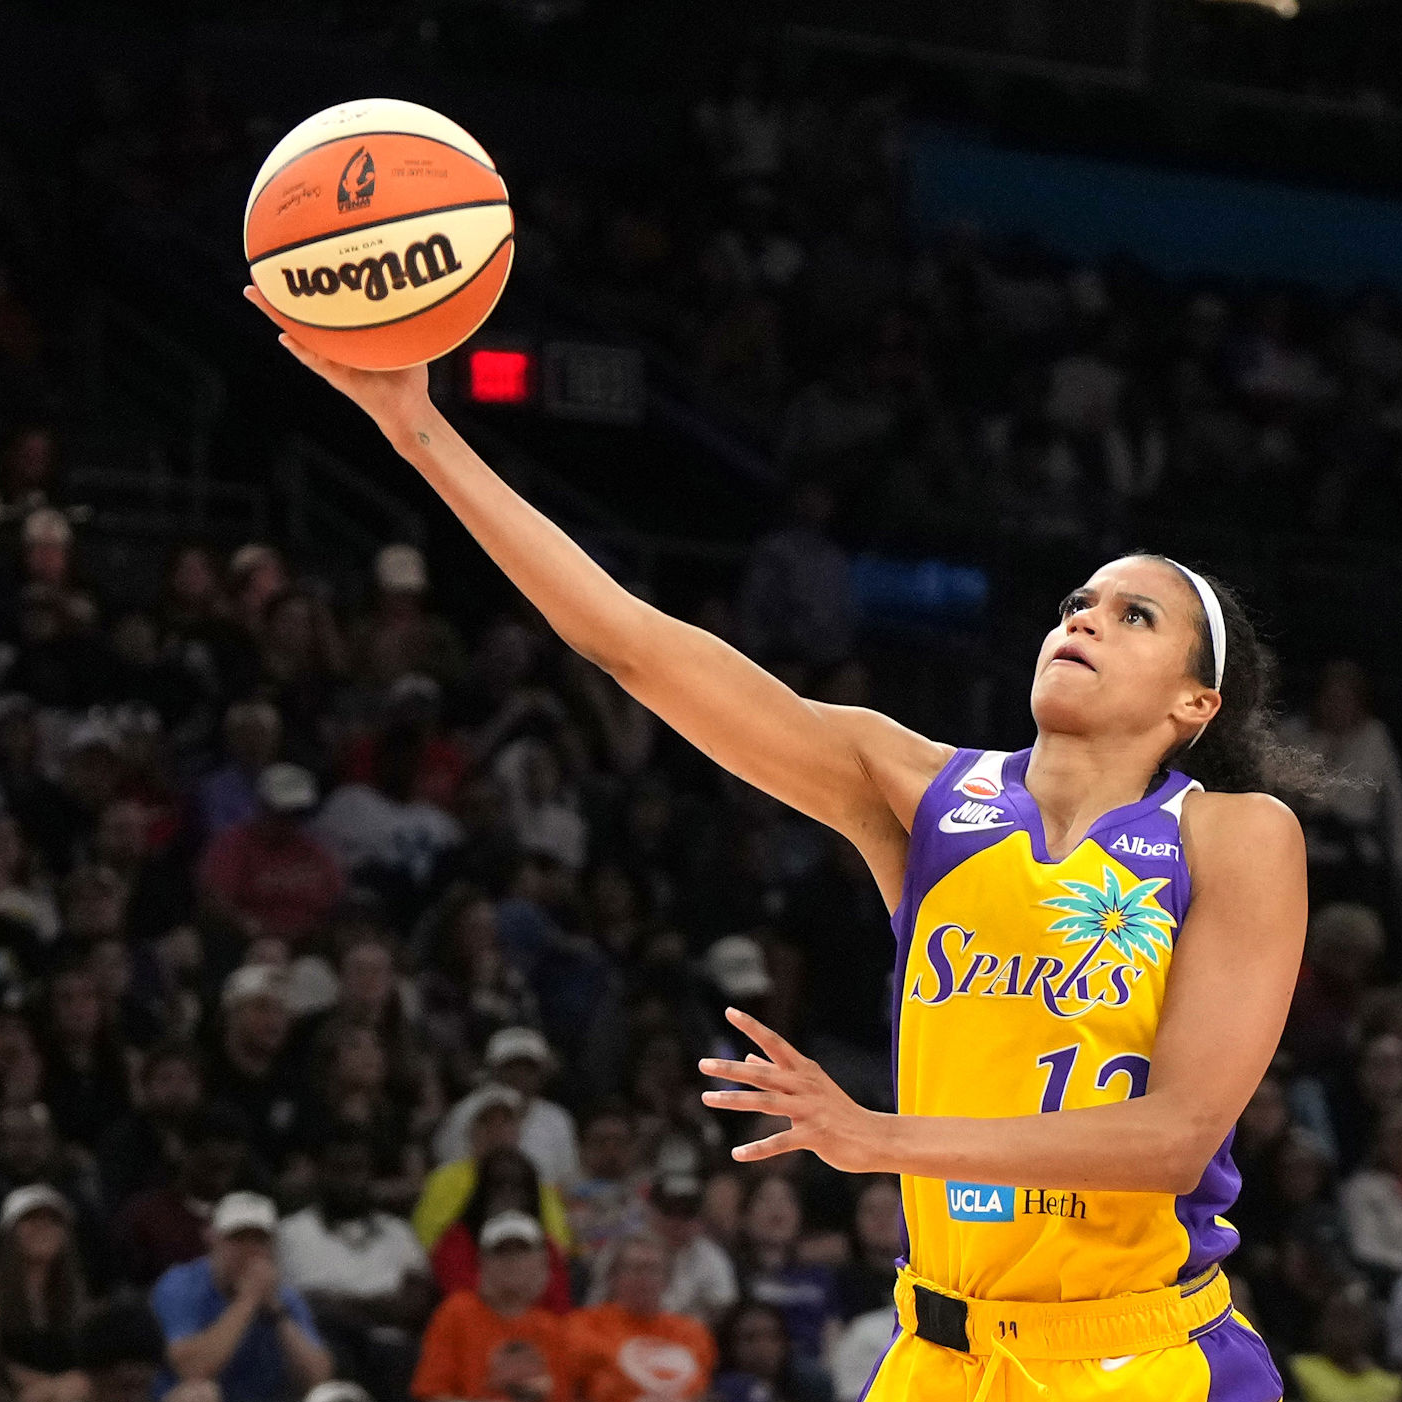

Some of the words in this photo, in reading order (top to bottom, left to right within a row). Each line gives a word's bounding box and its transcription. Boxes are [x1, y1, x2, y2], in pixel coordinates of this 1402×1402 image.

[281, 232, 463, 302] Wilson
[952, 800, 1005, 825] NIKE
[950, 1189, 1003, 1213] UCLA
